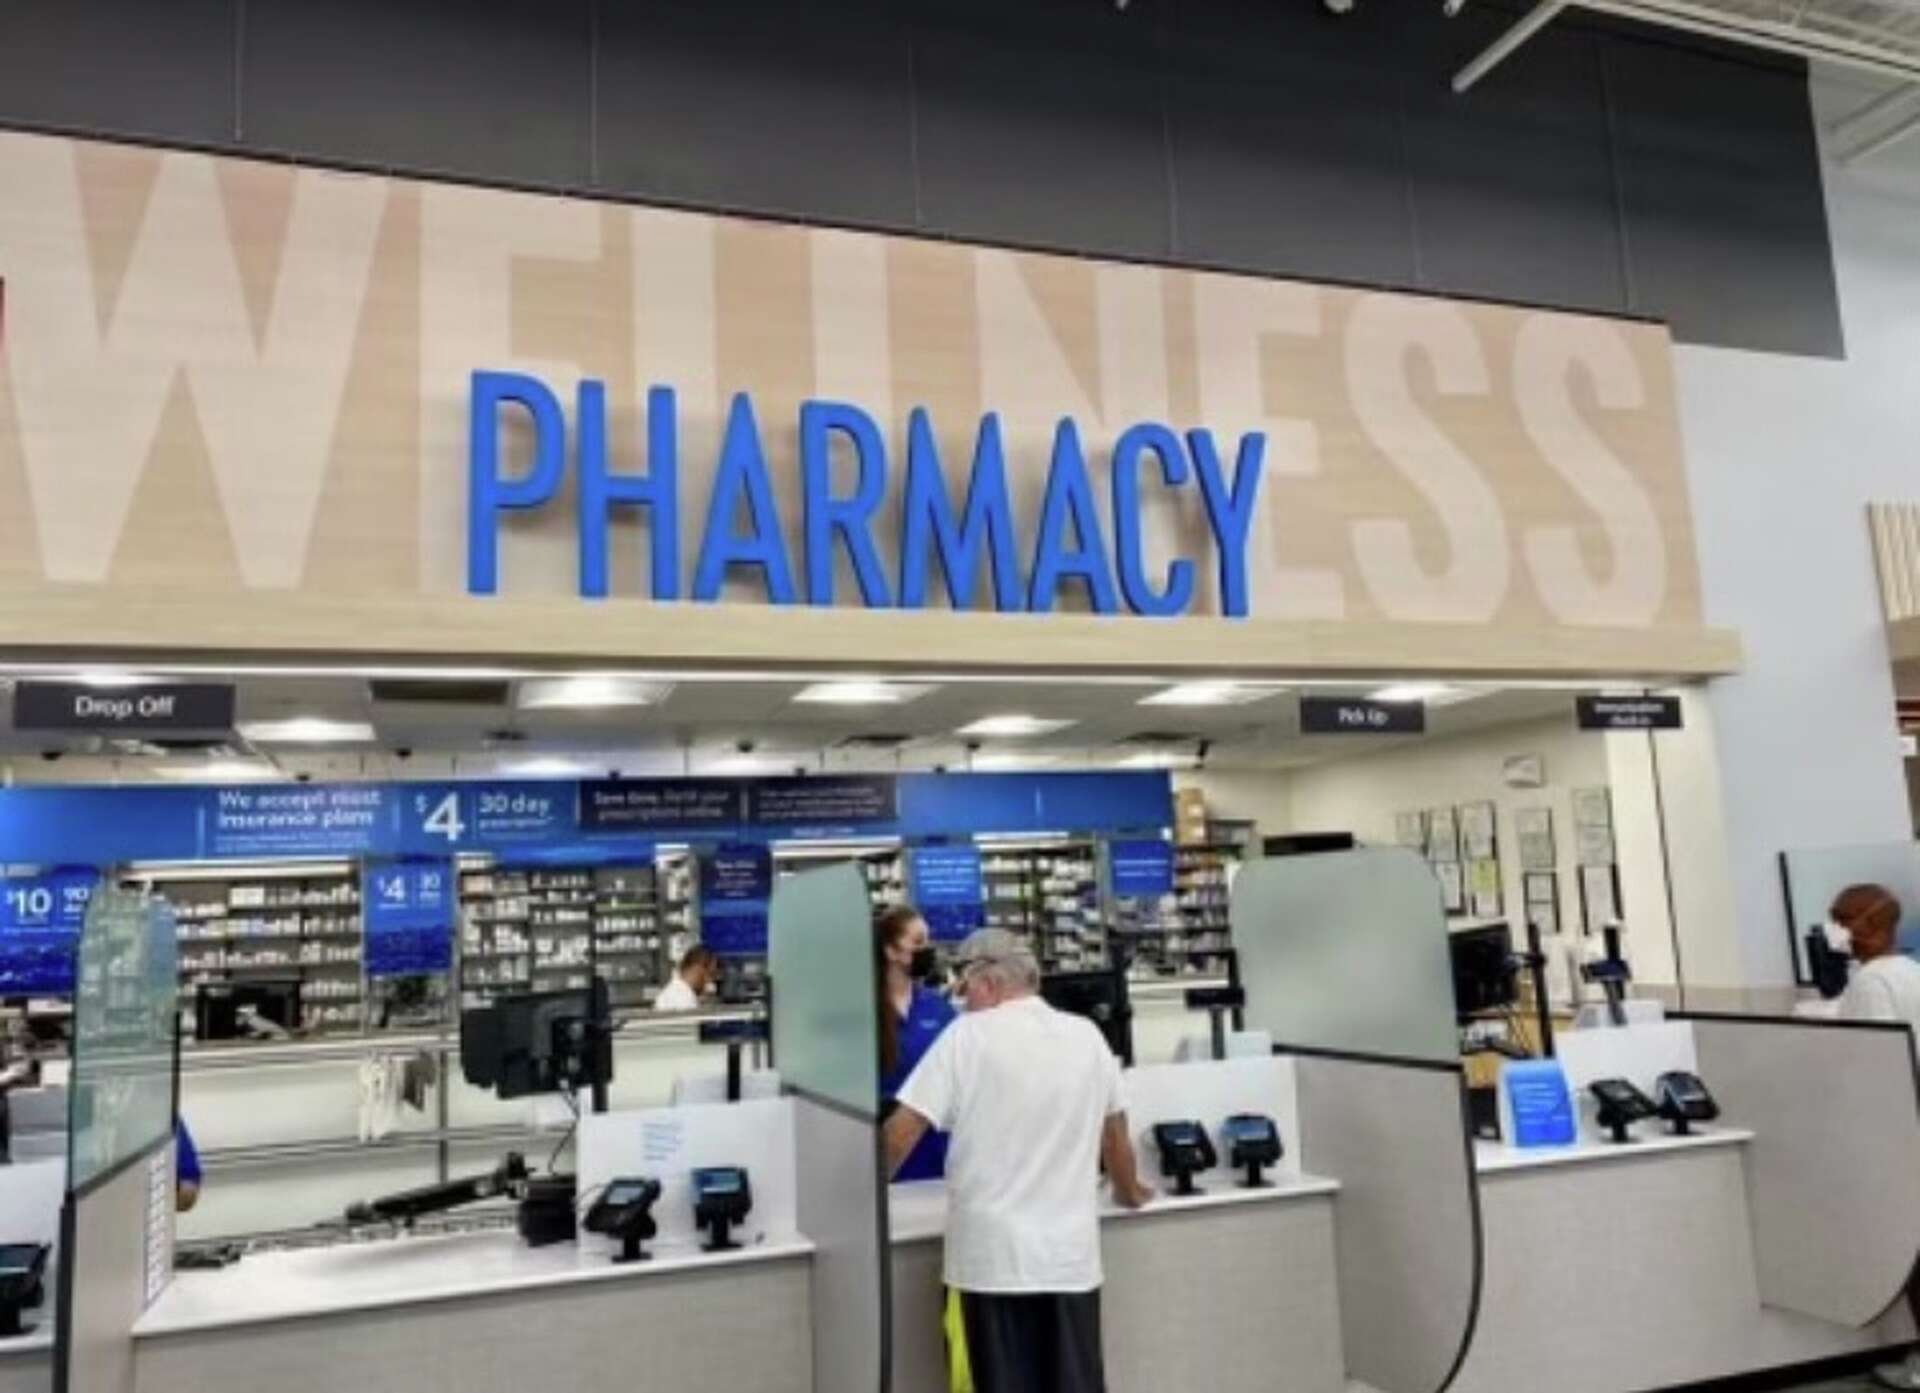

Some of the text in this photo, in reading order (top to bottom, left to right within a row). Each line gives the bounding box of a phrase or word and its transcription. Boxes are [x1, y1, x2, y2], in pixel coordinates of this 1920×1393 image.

[467, 368, 1267, 618] PHARMACY
[74, 695, 176, 719] Drop Off
[218, 790, 252, 810] We
[479, 791, 551, 817] 30 day
